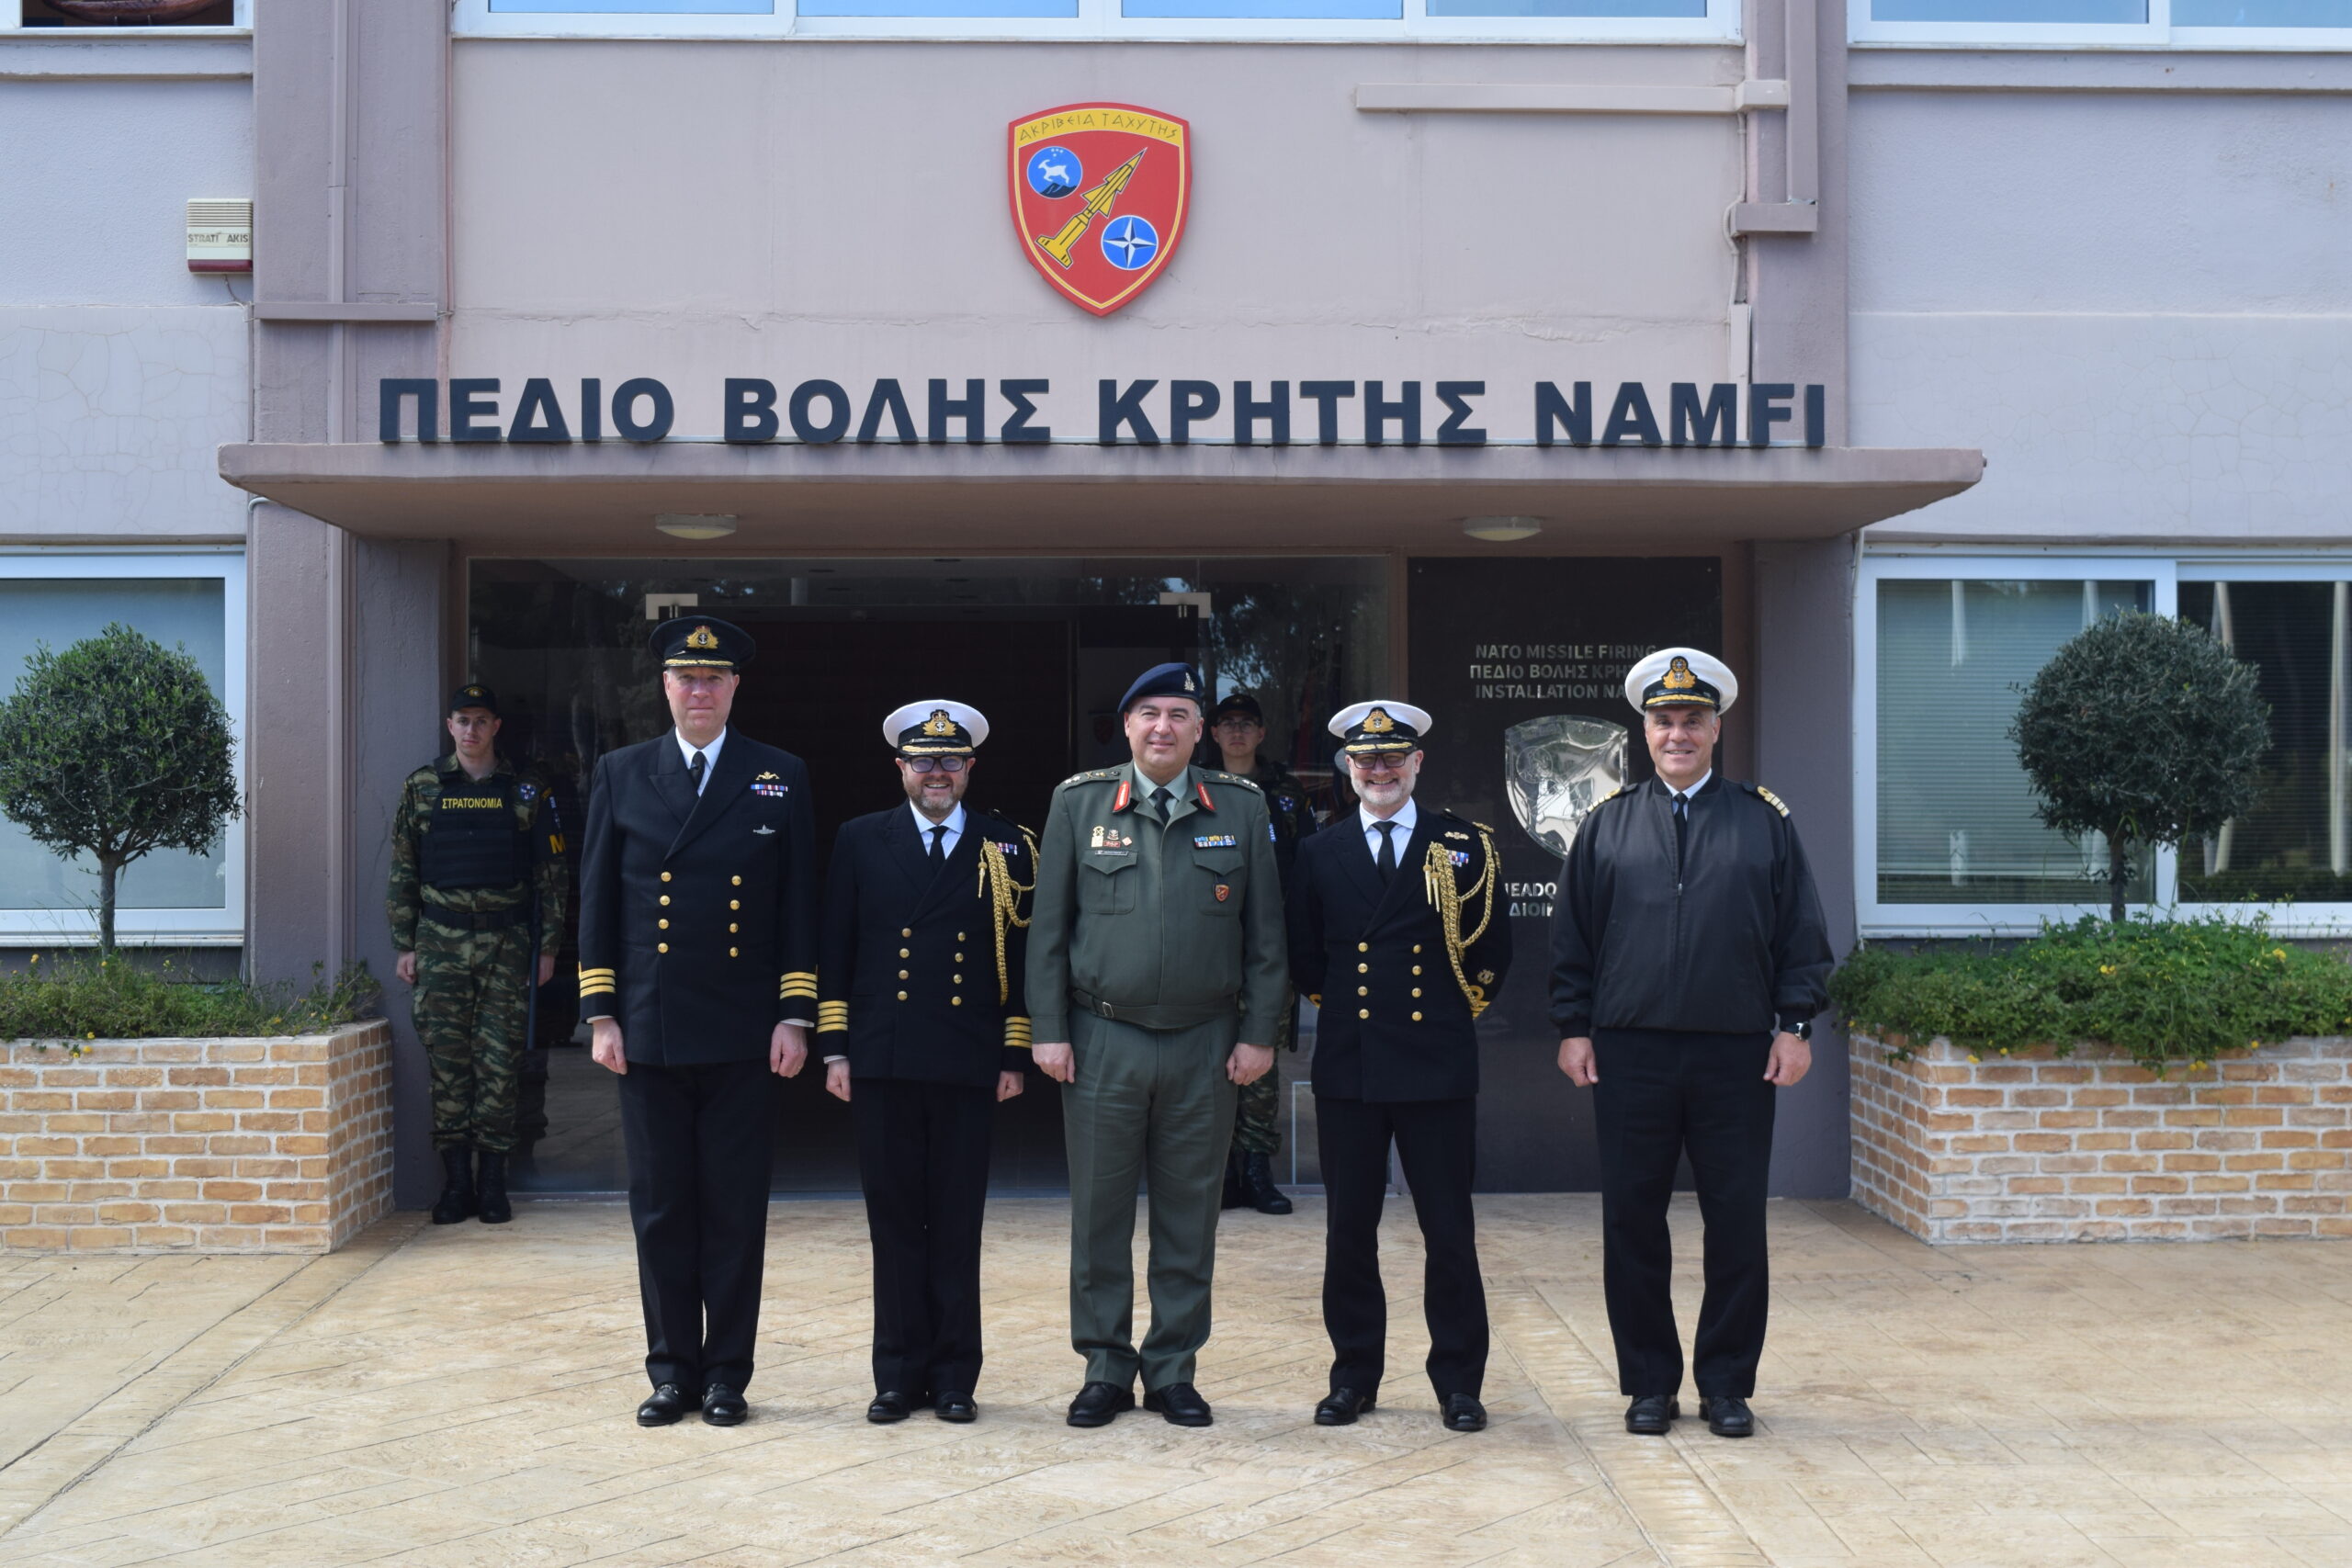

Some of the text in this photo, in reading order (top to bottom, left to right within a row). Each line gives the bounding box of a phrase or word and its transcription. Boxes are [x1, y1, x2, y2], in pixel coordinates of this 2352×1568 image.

[1019, 113, 1095, 141] ΑΚΡΙΒΕΙΑ
[379, 377, 1826, 447] ΠΕΔΙΟ ΒΟΛΗΣ ΚΡΗΤΗΣ NAMFI
[1476, 644, 1521, 660] NATO
[1526, 644, 1594, 660] MISSILE
[1470, 664, 1524, 679] ΠΕΔΙΟ
[1530, 664, 1589, 679] ΒΟΛΗΣ
[1476, 683, 1626, 699] INSTALLATION NA
[442, 797, 503, 810] ΣΤΡΑΤΟΝΟΜΙΑ
